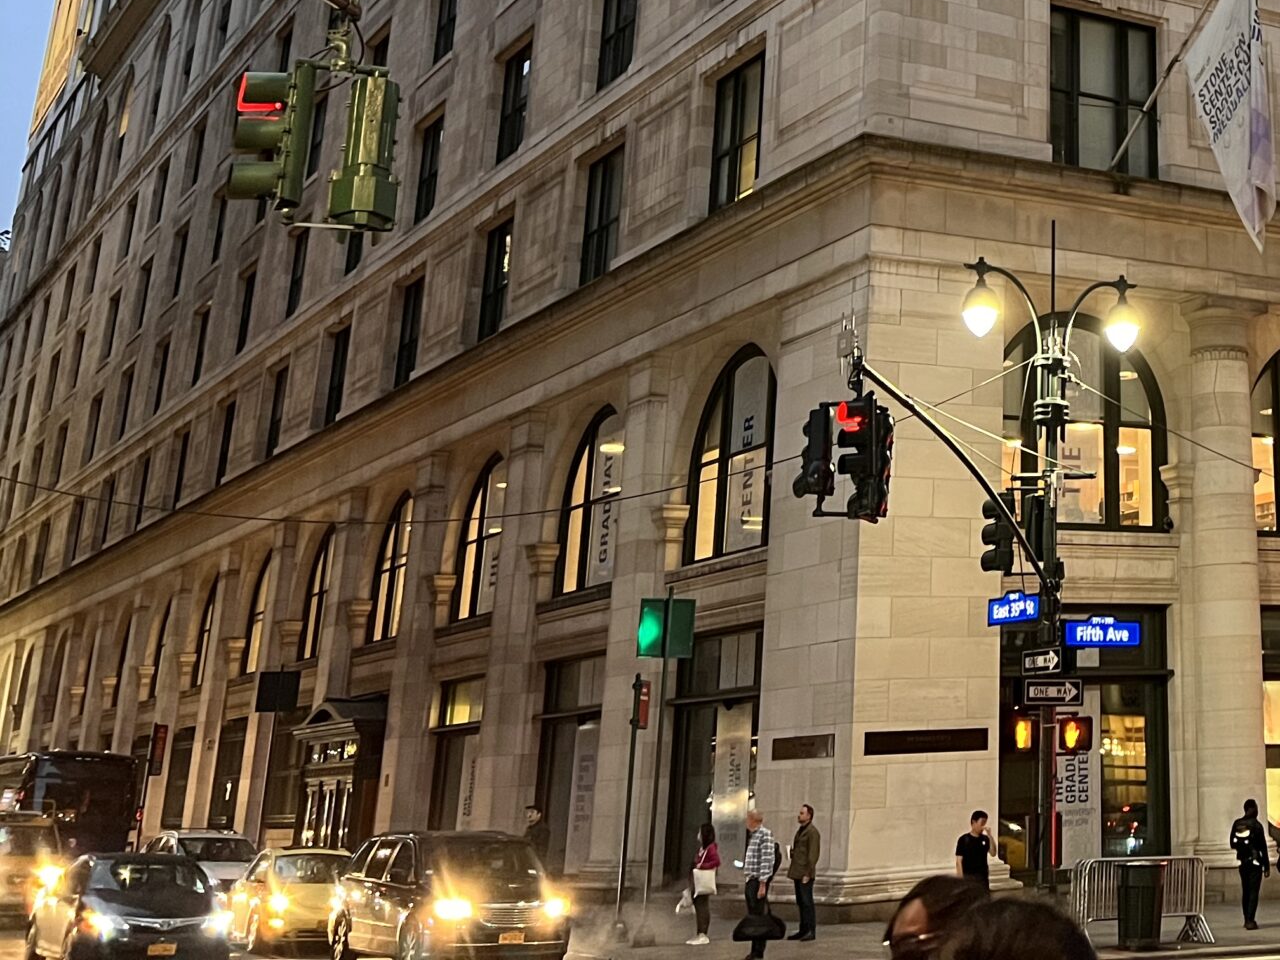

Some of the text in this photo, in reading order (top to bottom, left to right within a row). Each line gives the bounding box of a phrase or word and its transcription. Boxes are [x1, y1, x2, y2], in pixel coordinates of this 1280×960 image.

[1198, 52, 1229, 103] STONE
[1202, 58, 1235, 117] CENTER
[740, 414, 755, 526] CENTER
[599, 445, 618, 563] GRADAT
[993, 604, 1009, 620] East
[1025, 599, 1035, 616] St
[1076, 626, 1130, 642] Fifth Ave
[1027, 653, 1056, 667] ONE WAY
[1033, 687, 1074, 697] ONE WAY
[1065, 755, 1077, 804] GRADU
